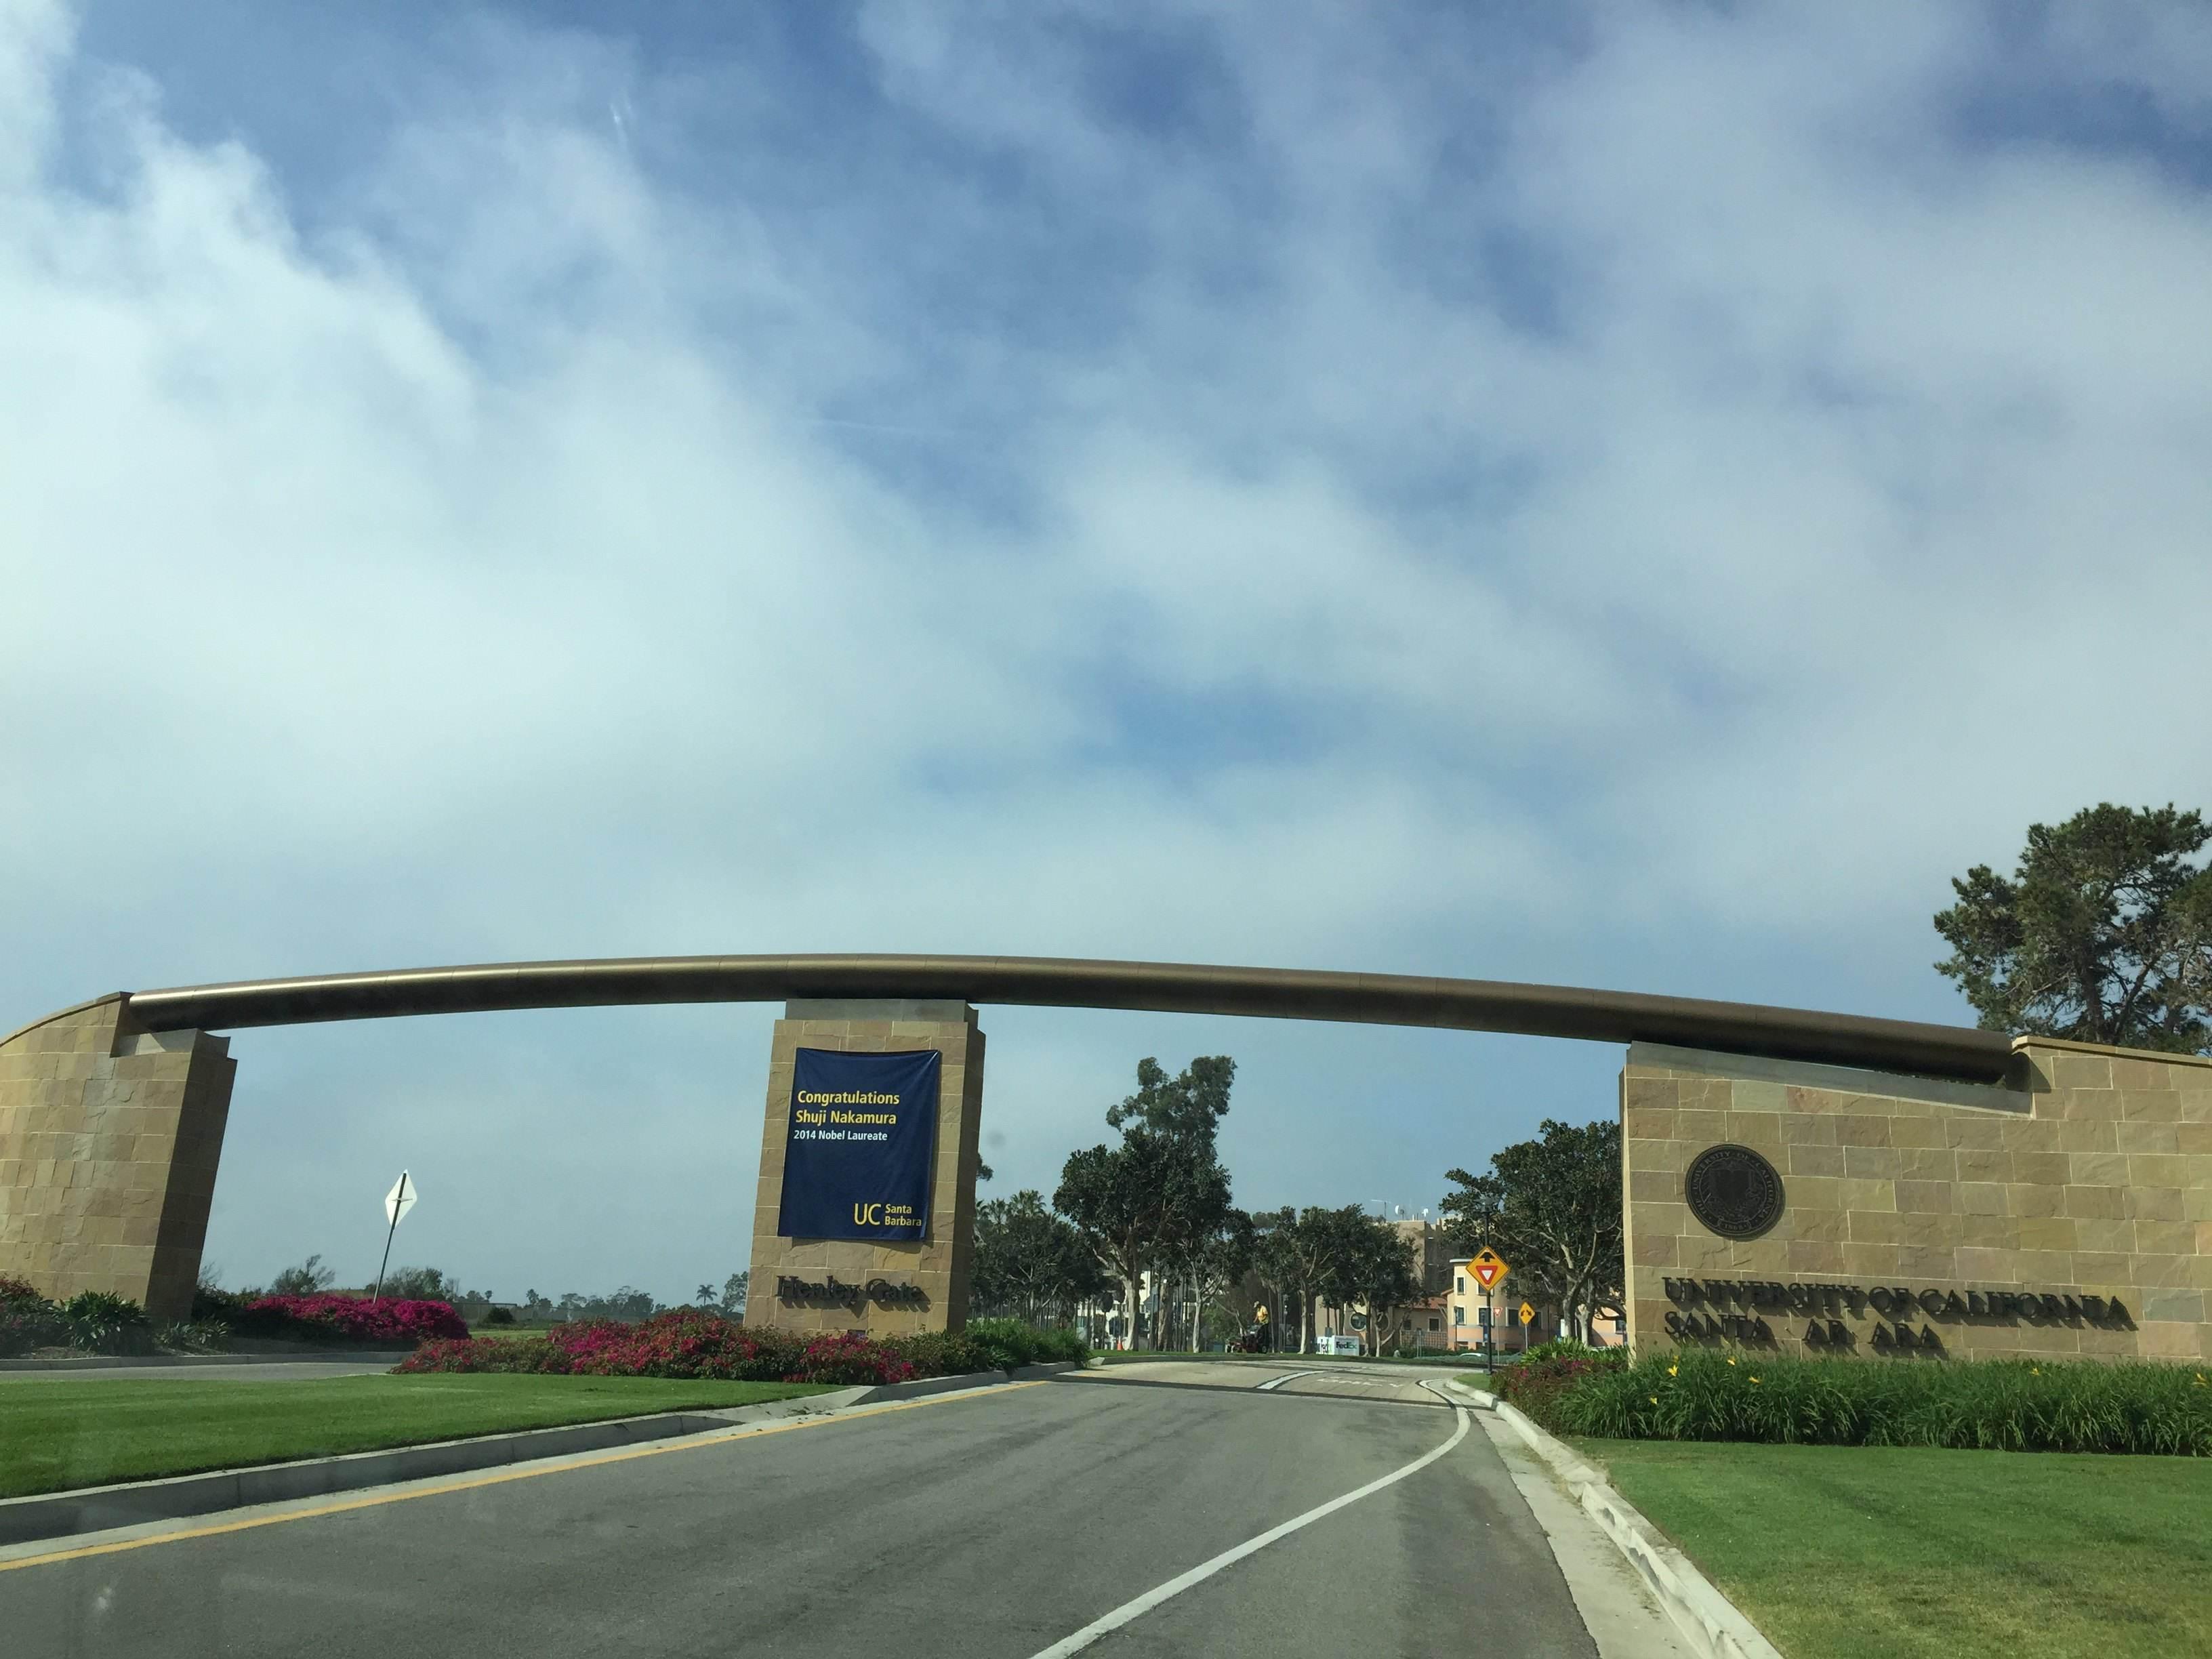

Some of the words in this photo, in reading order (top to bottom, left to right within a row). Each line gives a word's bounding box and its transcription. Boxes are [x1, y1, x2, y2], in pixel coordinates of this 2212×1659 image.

[797, 1090, 900, 1107] Congratulations
[796, 1109, 826, 1126] Shuji
[830, 1110, 897, 1124] Nakamura
[794, 1130, 817, 1139] 2014
[819, 1130, 845, 1140] Nobel
[848, 1130, 888, 1141] Laureate
[853, 1203, 882, 1226] UC
[884, 1204, 912, 1214] Santa
[884, 1216, 922, 1227] Barbara
[1662, 1277, 1860, 1309] UNIVERSITY
[1868, 1286, 1910, 1313] OF
[1918, 1288, 2129, 1322] CALIFORNIA
[1664, 1311, 1771, 1341] SANTA
